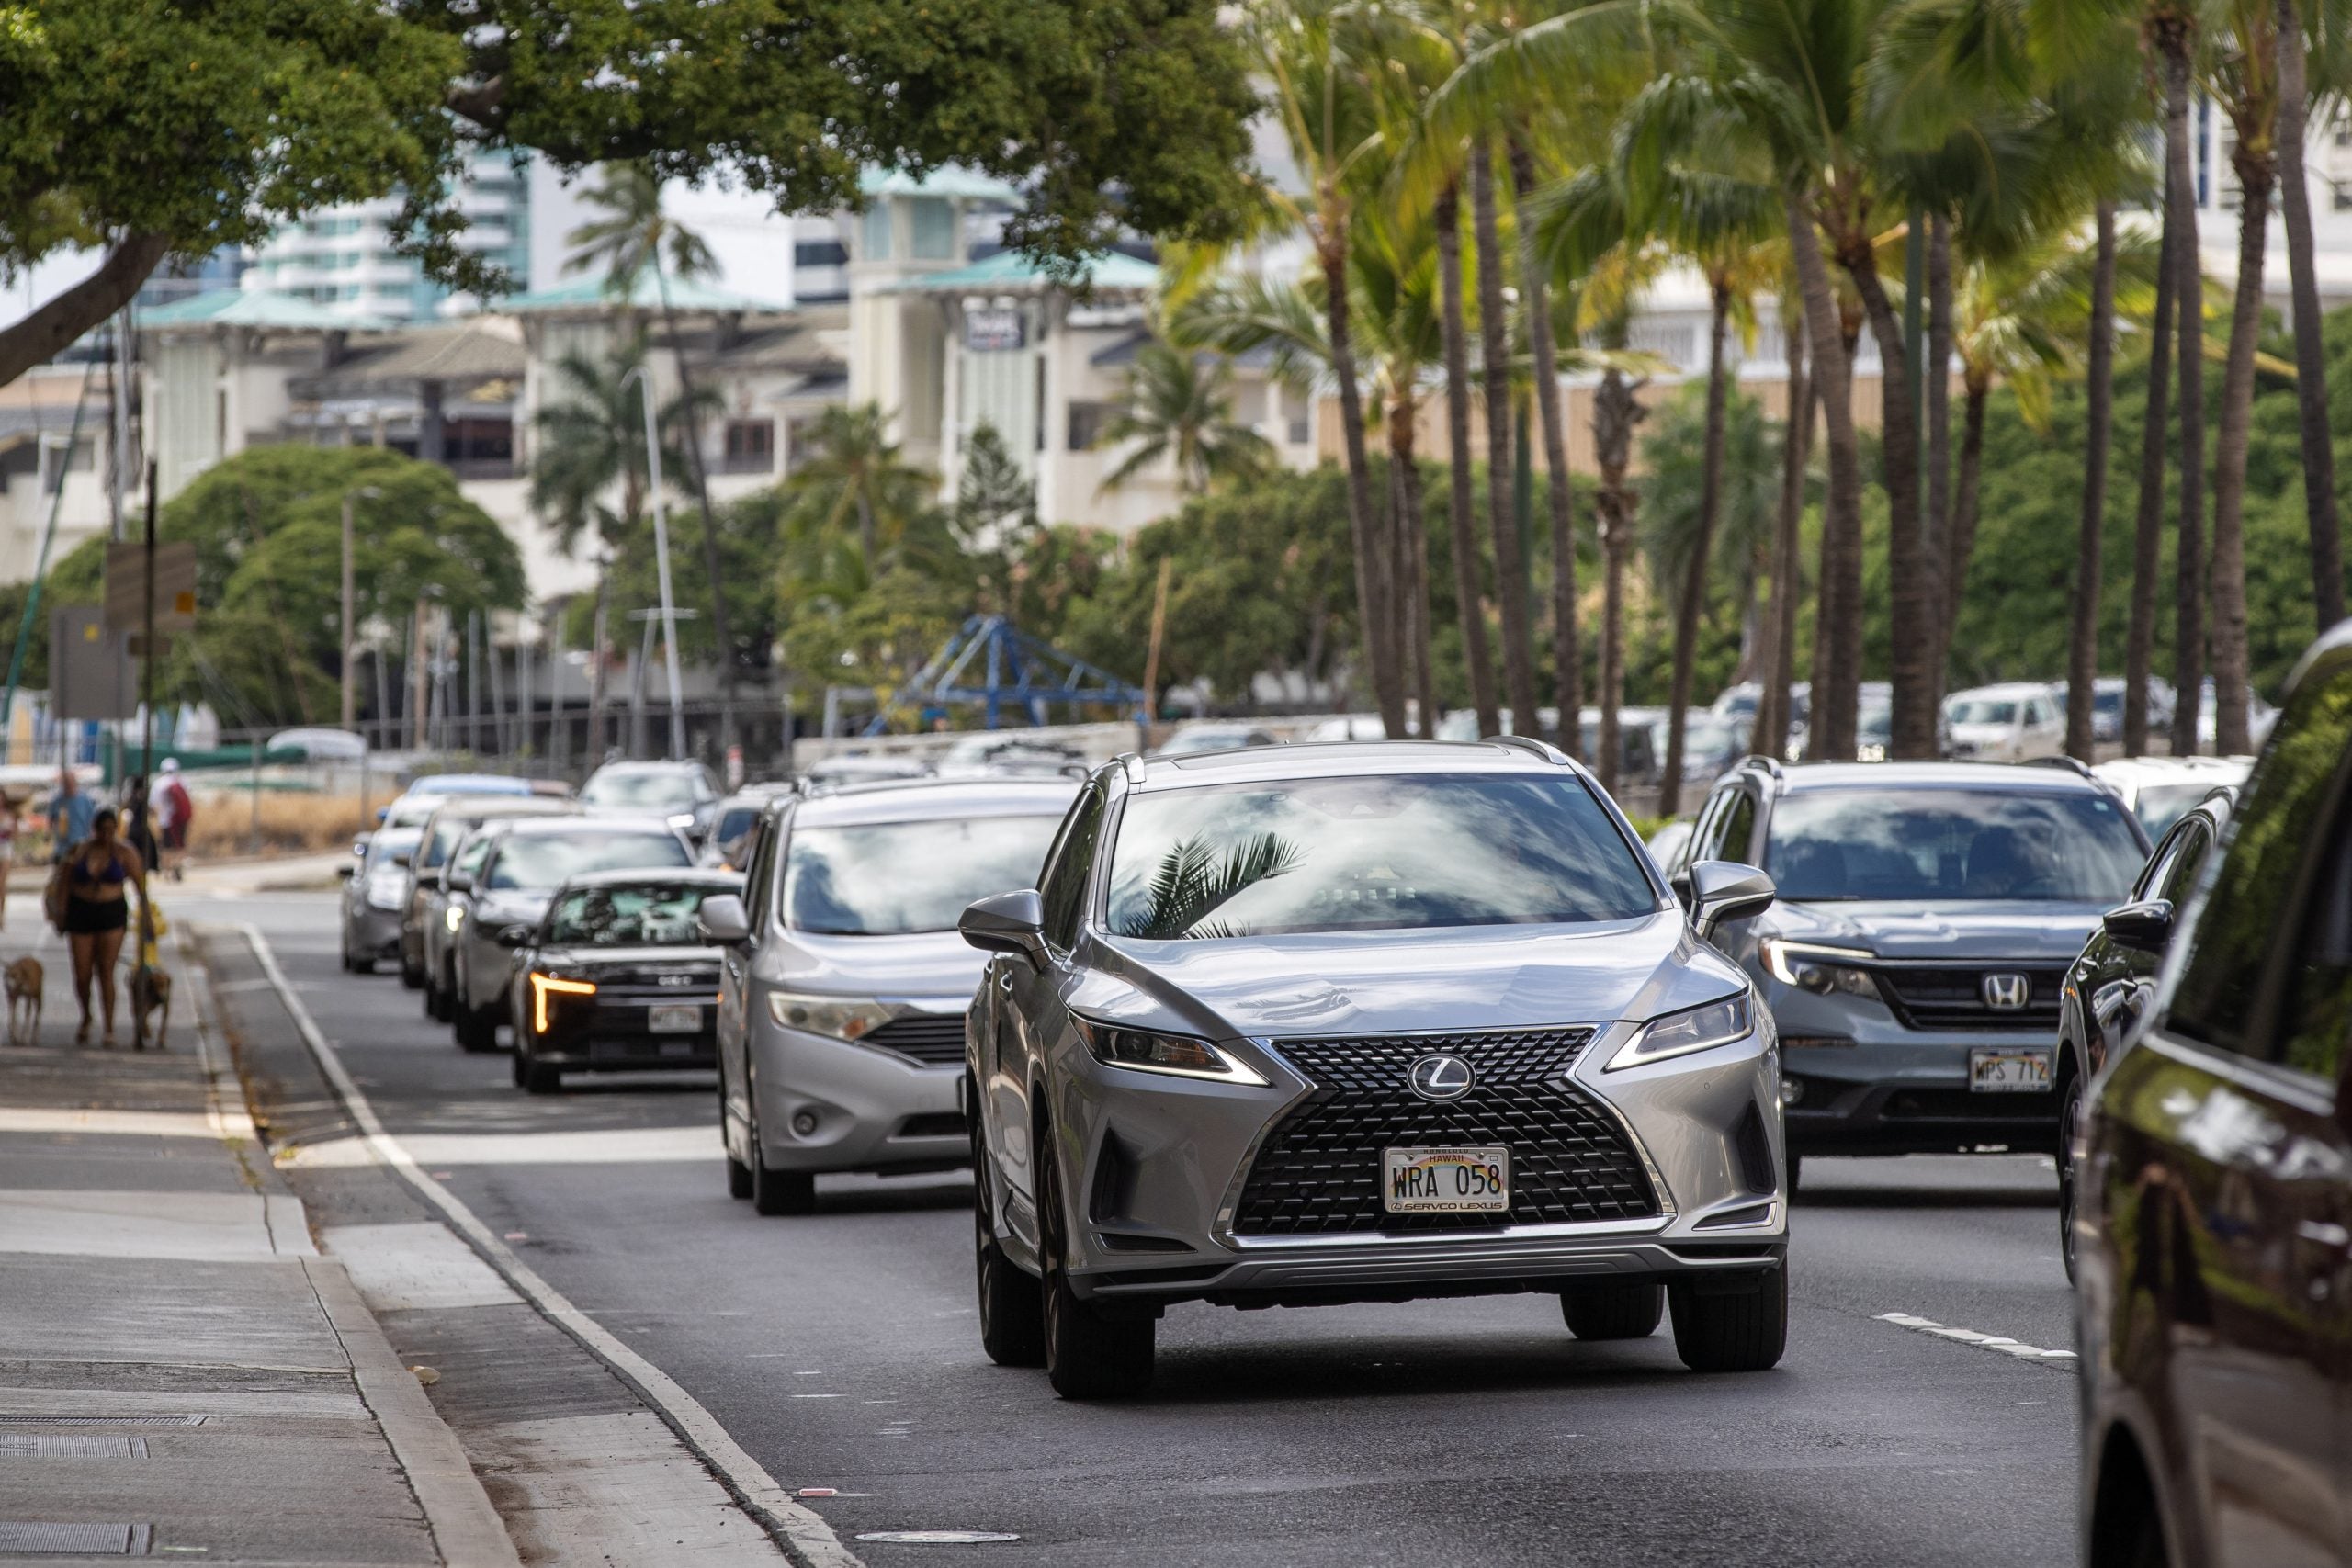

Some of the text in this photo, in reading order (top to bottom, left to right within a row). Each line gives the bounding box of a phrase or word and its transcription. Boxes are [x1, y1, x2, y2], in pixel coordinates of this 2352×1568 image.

[1975, 1060, 2006, 1081] WPS
[1393, 1163, 1501, 1198] WRA 058
[1403, 1202, 1457, 1211] SERVCO
